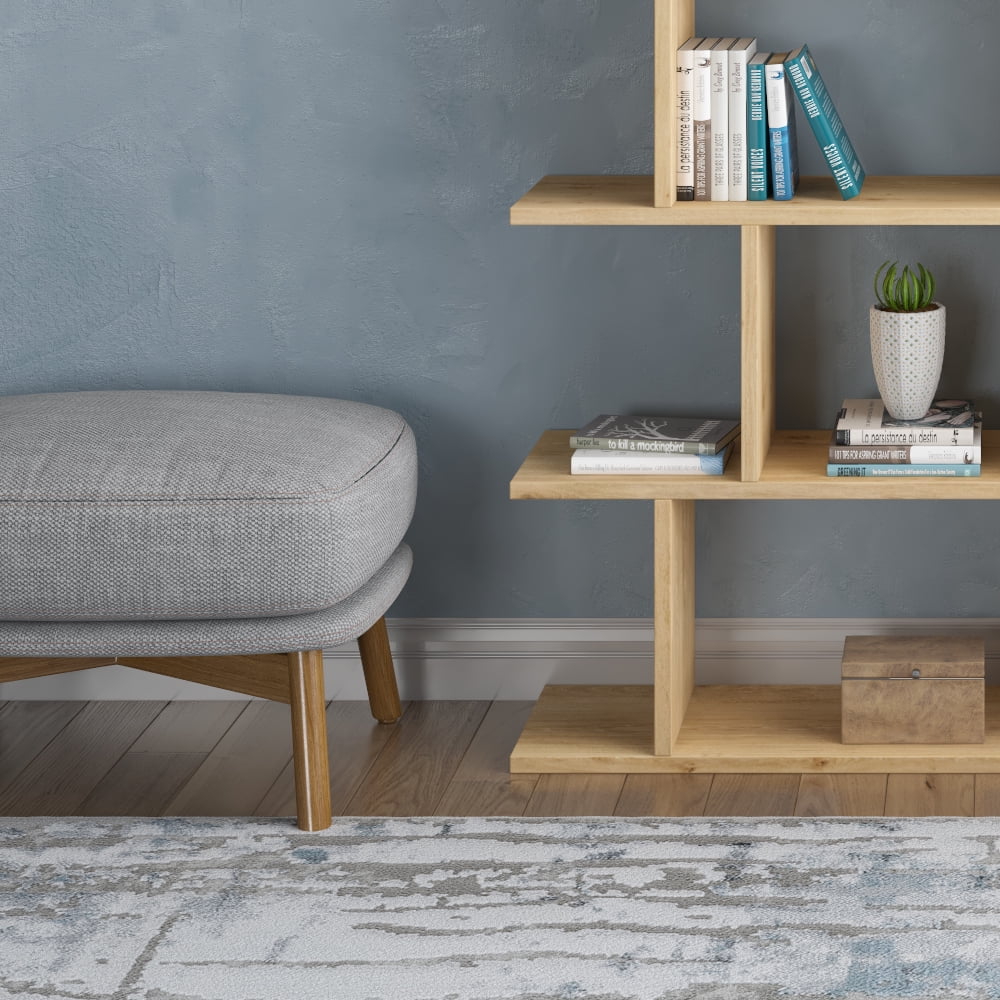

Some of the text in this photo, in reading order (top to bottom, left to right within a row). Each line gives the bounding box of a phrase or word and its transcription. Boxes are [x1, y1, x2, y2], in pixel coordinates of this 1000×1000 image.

[676, 90, 691, 111] destin
[823, 143, 843, 168] VOICES
[676, 165, 690, 174] La
[750, 148, 765, 192] SILENT VOICES
[833, 166, 853, 190] SILENT
[608, 439, 685, 454] to kill a mockingbird
[862, 430, 869, 443] La
[918, 429, 938, 443] destin
